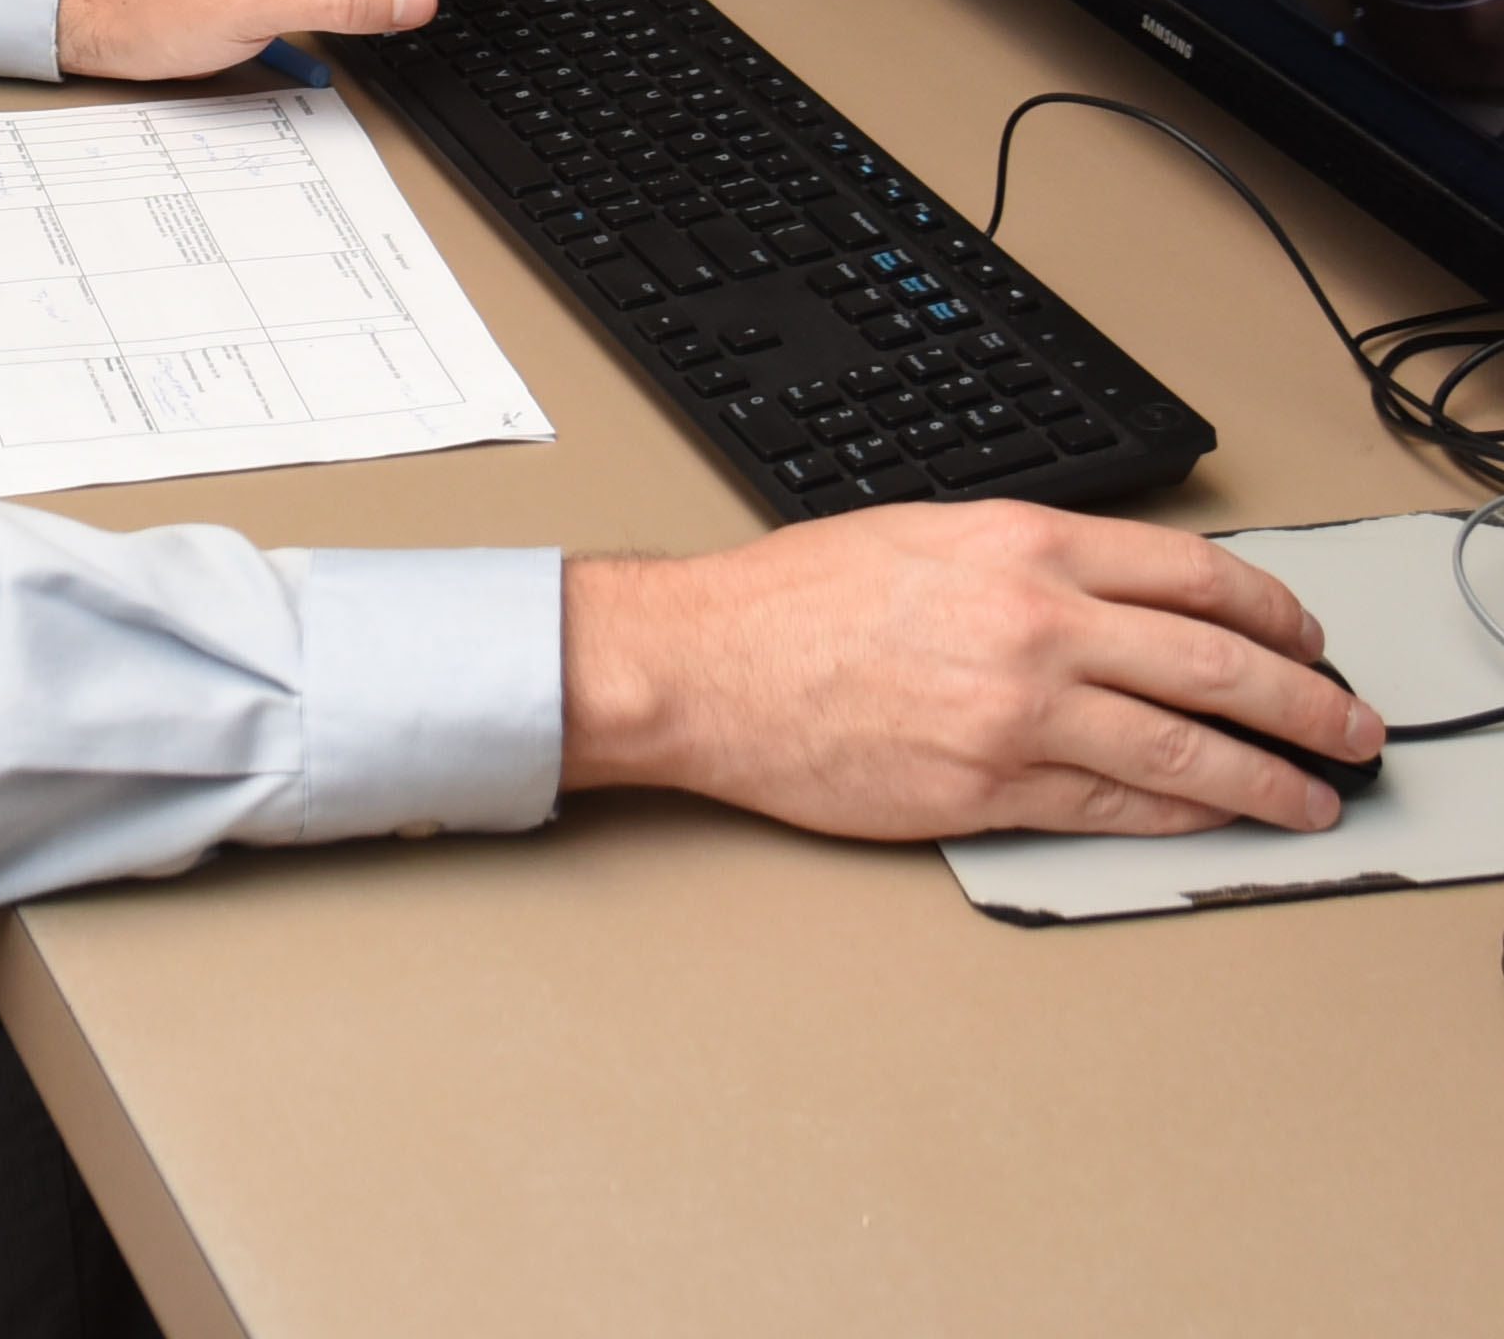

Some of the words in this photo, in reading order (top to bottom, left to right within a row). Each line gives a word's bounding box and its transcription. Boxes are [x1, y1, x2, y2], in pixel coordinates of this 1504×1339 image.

[1141, 13, 1193, 59] SAMSUNG
[578, 88, 592, 96] H
[536, 111, 550, 119] N
[557, 132, 572, 140] M
[644, 151, 656, 159] L
[989, 405, 1003, 413] 9
[839, 410, 853, 418] 2
[930, 422, 943, 430] 6
[868, 438, 882, 446] 3
